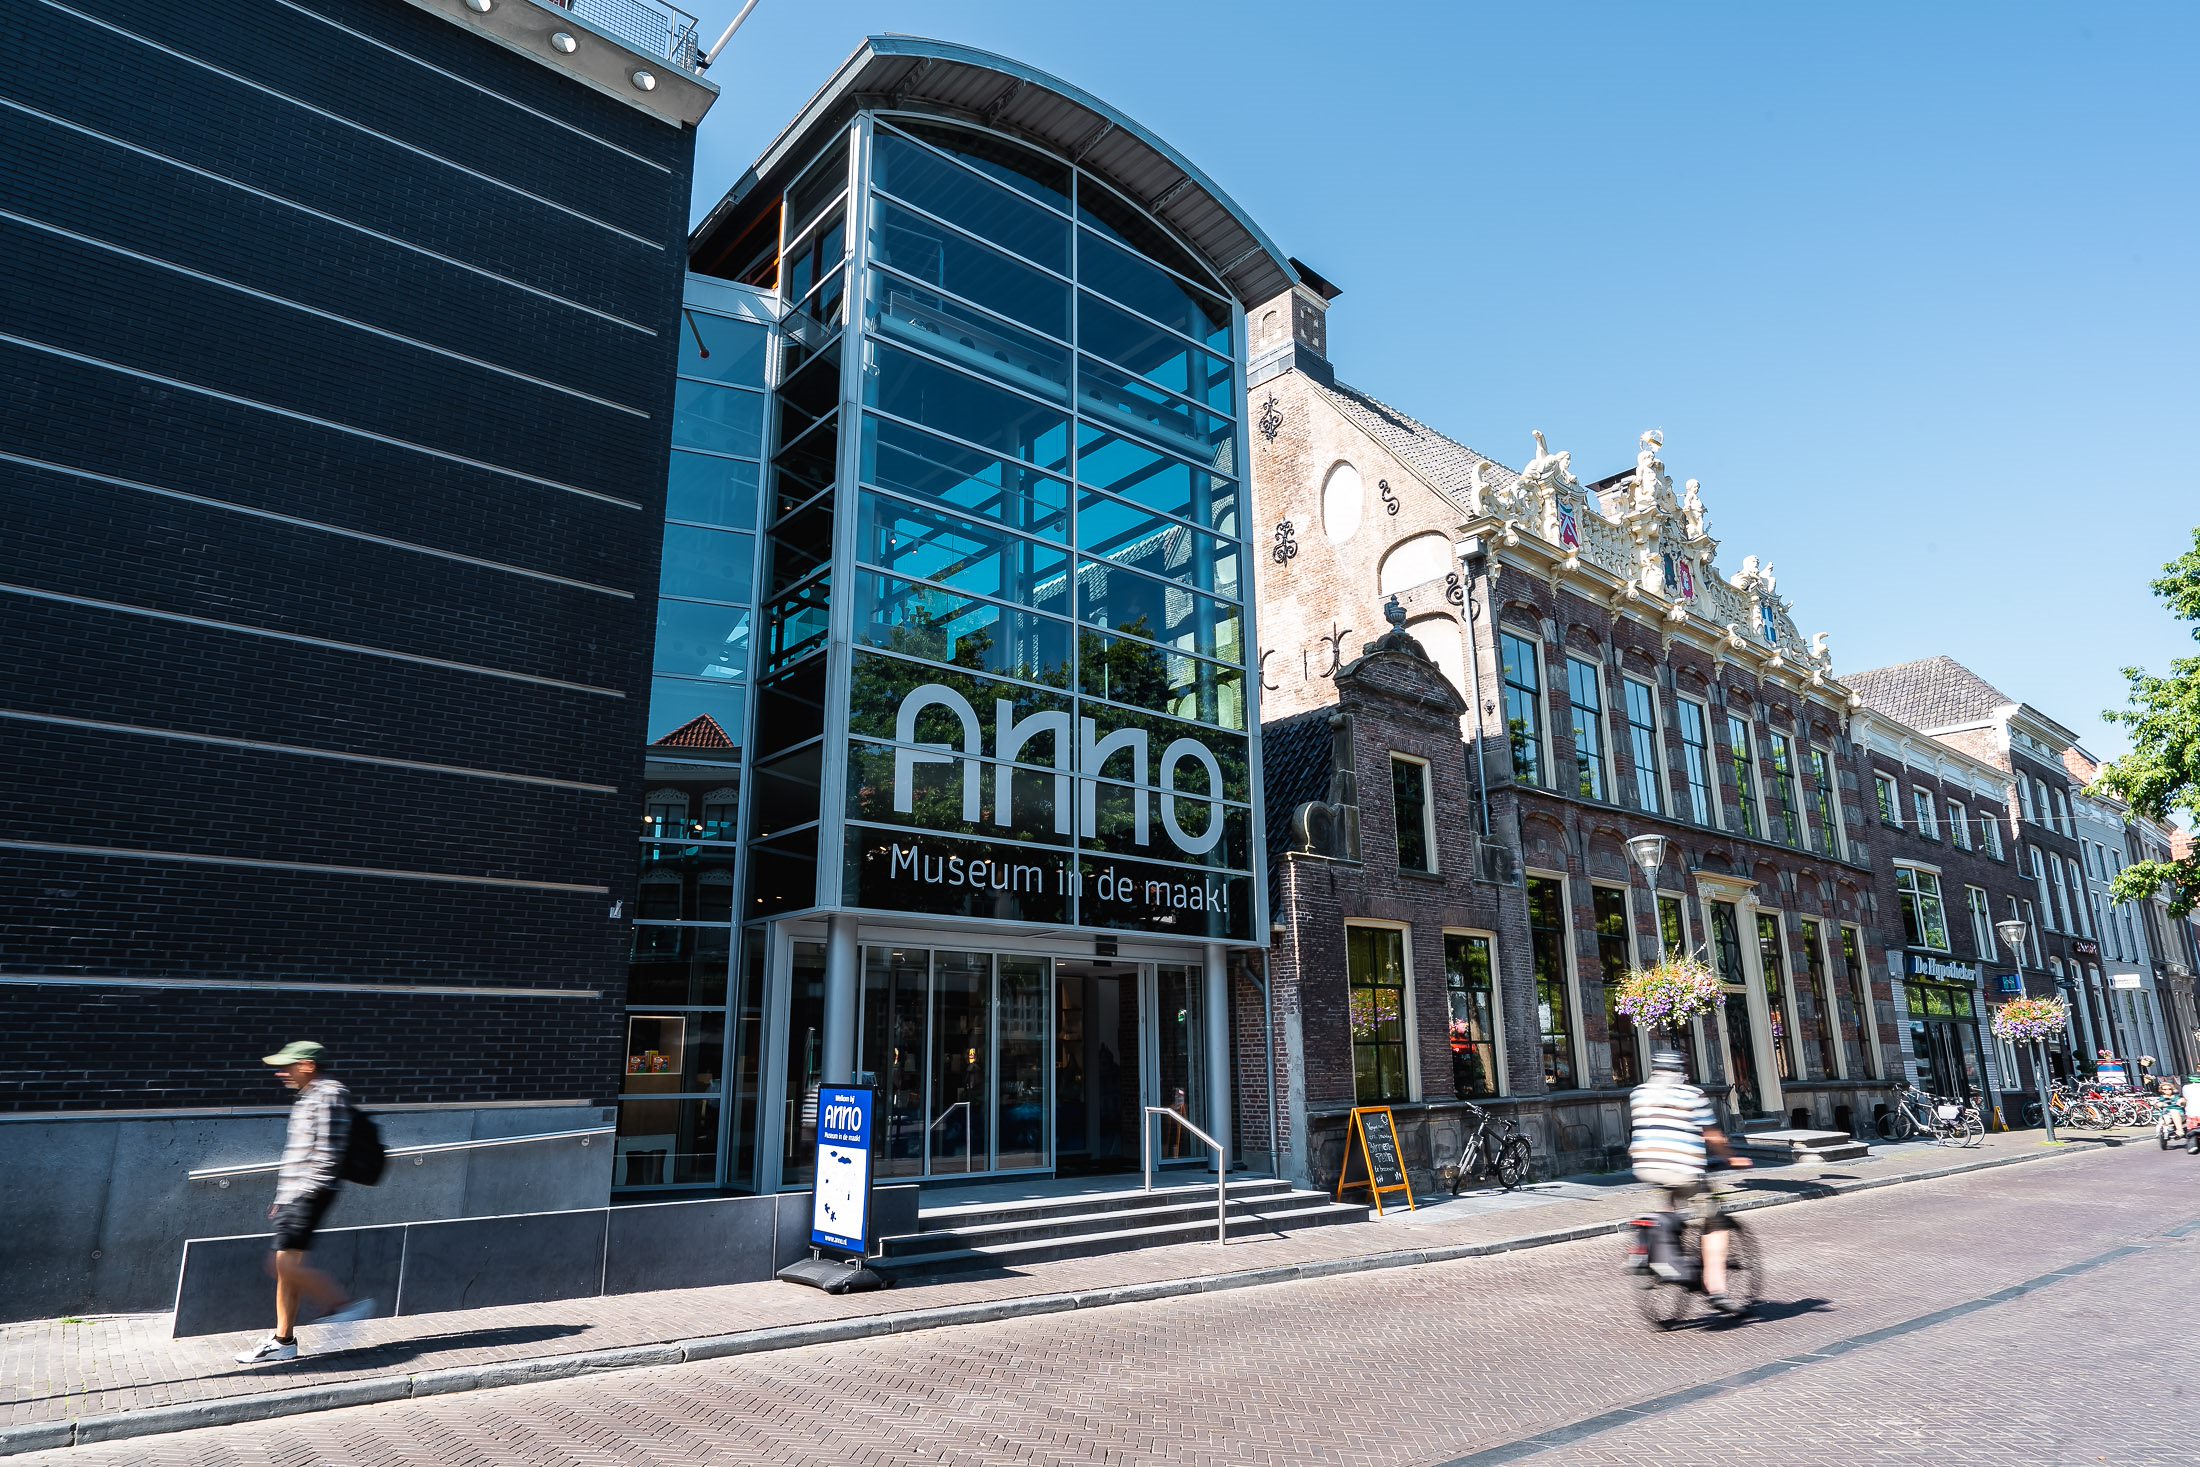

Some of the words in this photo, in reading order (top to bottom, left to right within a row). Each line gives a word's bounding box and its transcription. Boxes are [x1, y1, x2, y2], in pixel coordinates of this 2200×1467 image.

[890, 843, 1043, 894] Museum
[1058, 861, 1083, 898] in
[1097, 866, 1133, 903] de
[1145, 878, 1230, 914] maak!
[1914, 955, 1928, 975] De
[1928, 957, 1976, 982] Hypotheker
